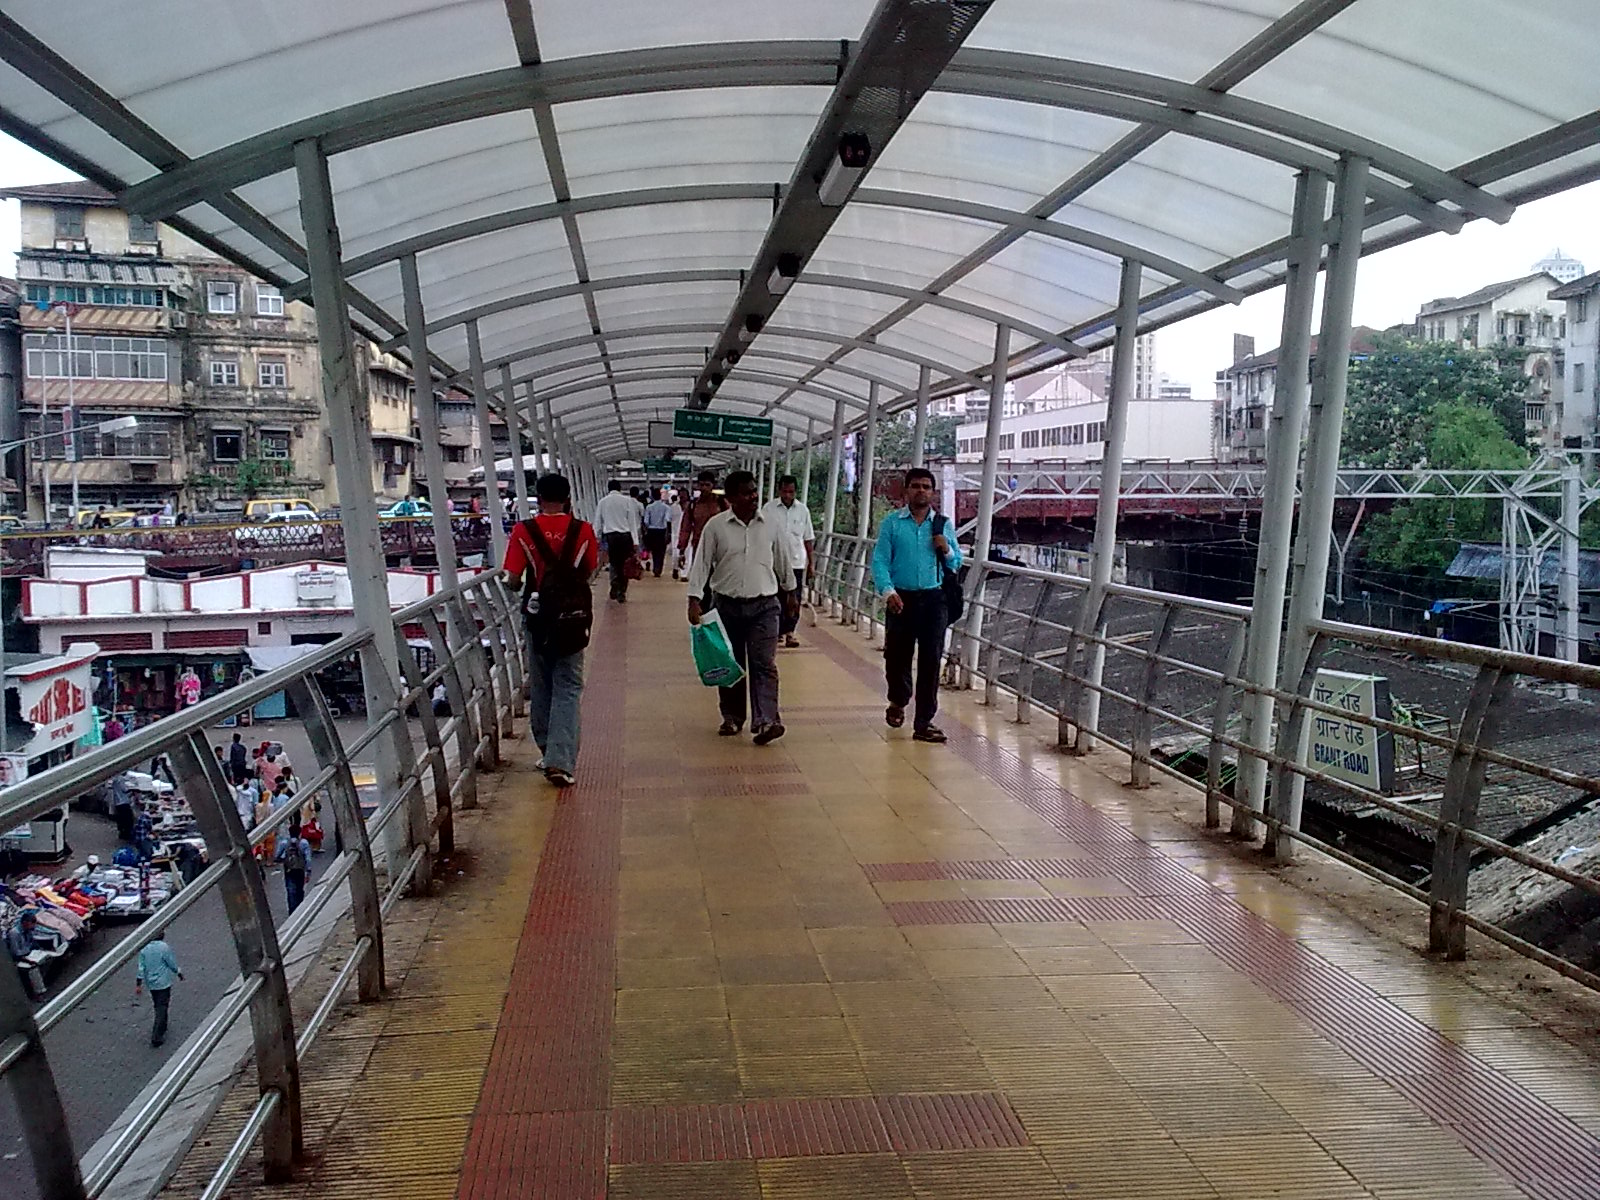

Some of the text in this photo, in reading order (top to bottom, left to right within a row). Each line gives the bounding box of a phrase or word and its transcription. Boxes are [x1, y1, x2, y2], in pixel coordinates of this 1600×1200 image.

[1338, 685, 1361, 713] रोड
[1344, 720, 1364, 746] रोड
[1314, 743, 1369, 775] GRANT ROAD
